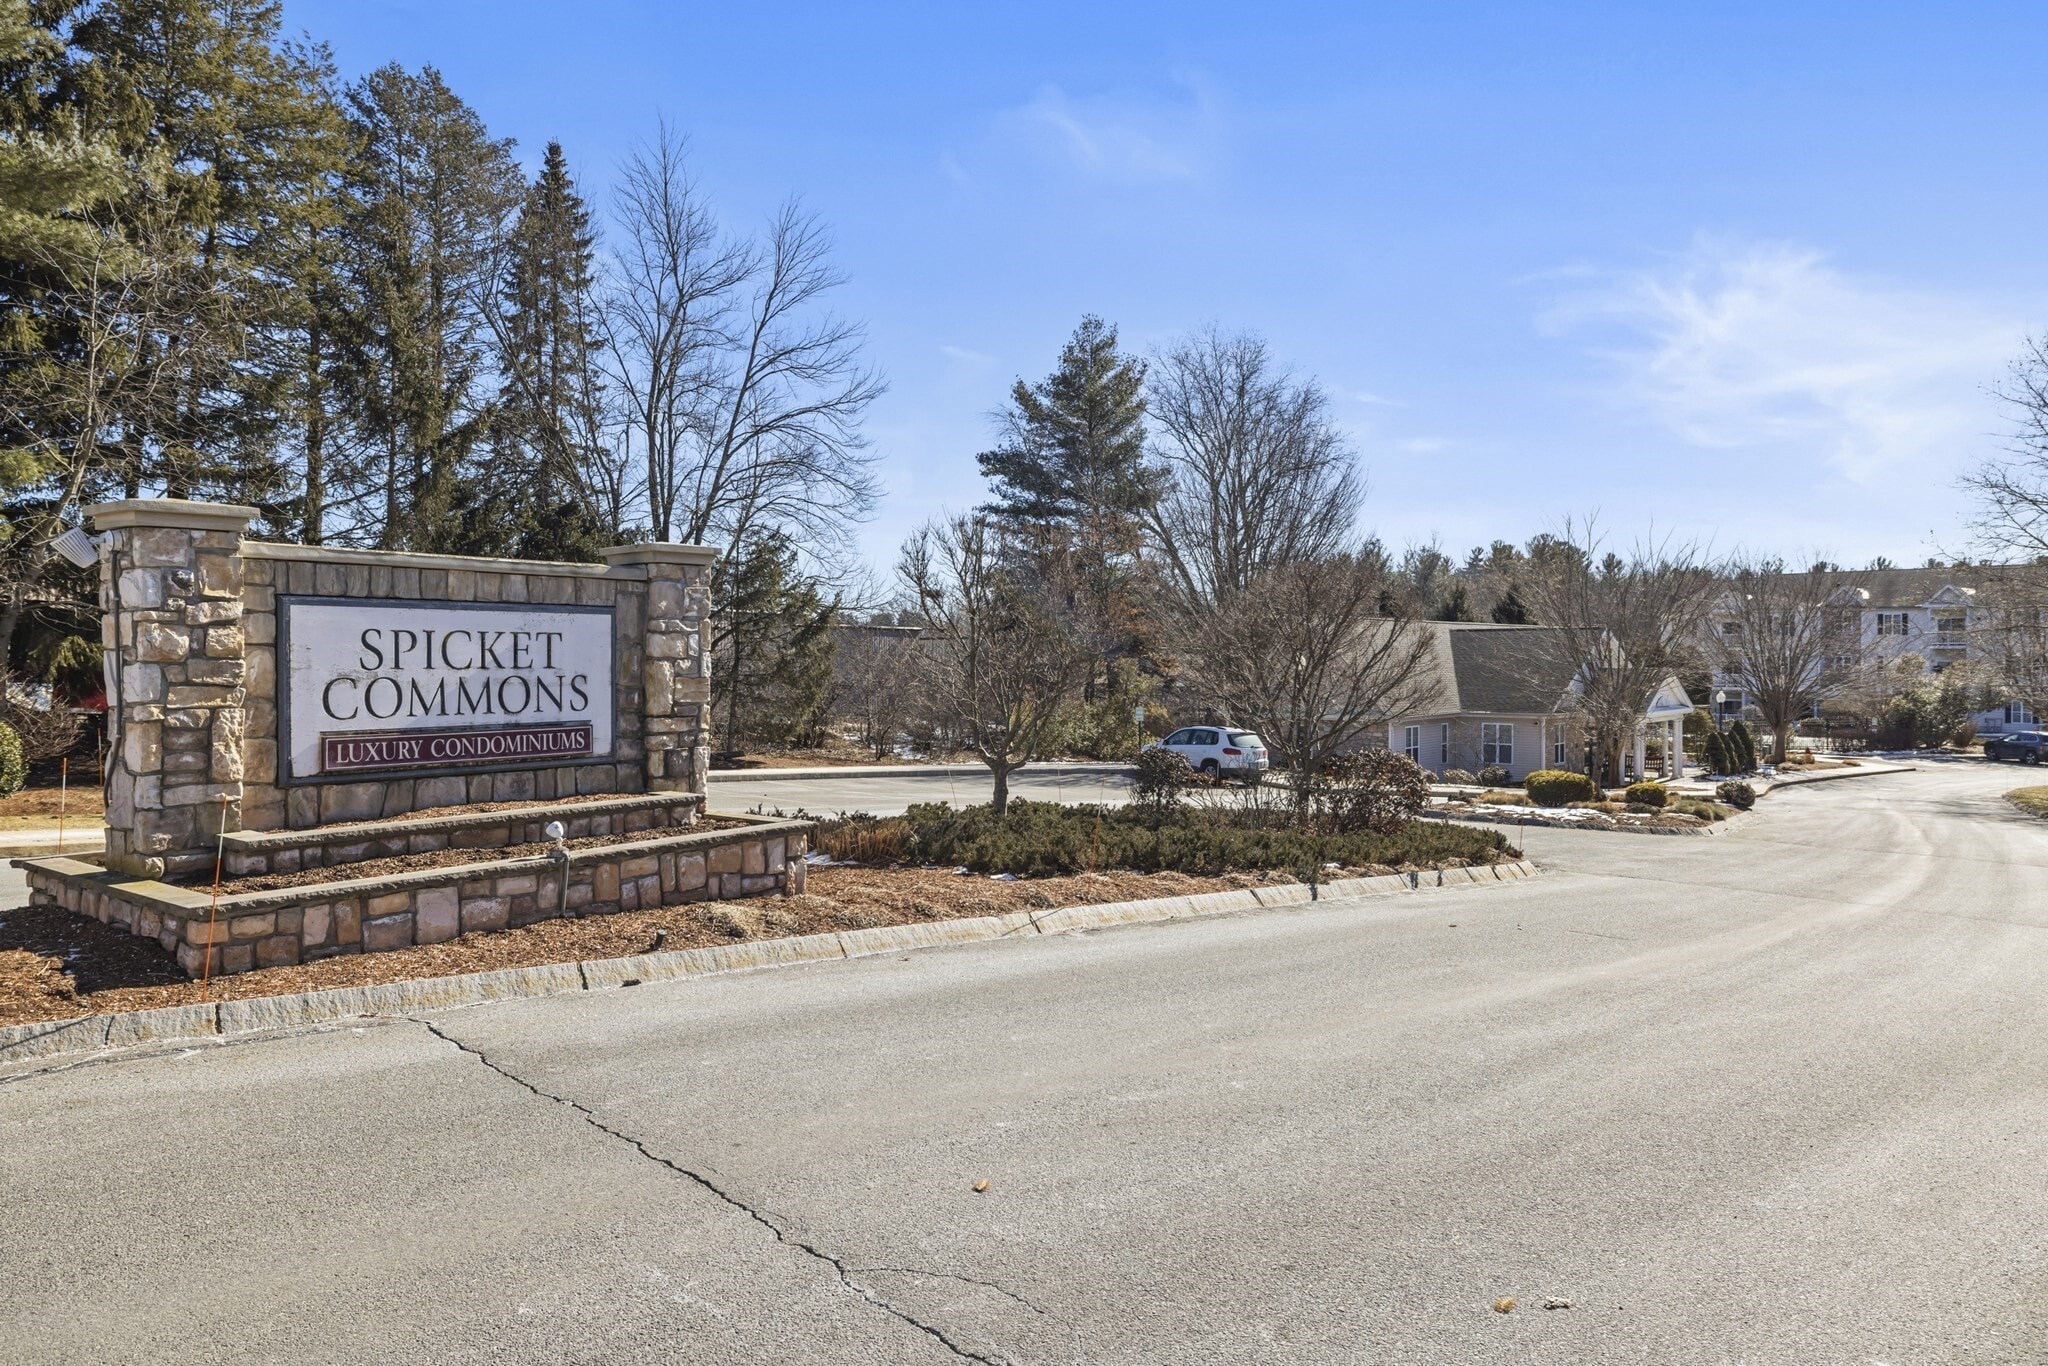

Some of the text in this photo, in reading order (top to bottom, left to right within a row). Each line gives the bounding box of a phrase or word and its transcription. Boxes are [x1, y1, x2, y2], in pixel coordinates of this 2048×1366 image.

[359, 628, 563, 671] SPICKET
[322, 674, 589, 720] COMMONS
[336, 731, 585, 764] LUXURY CONDOMINIUMS
